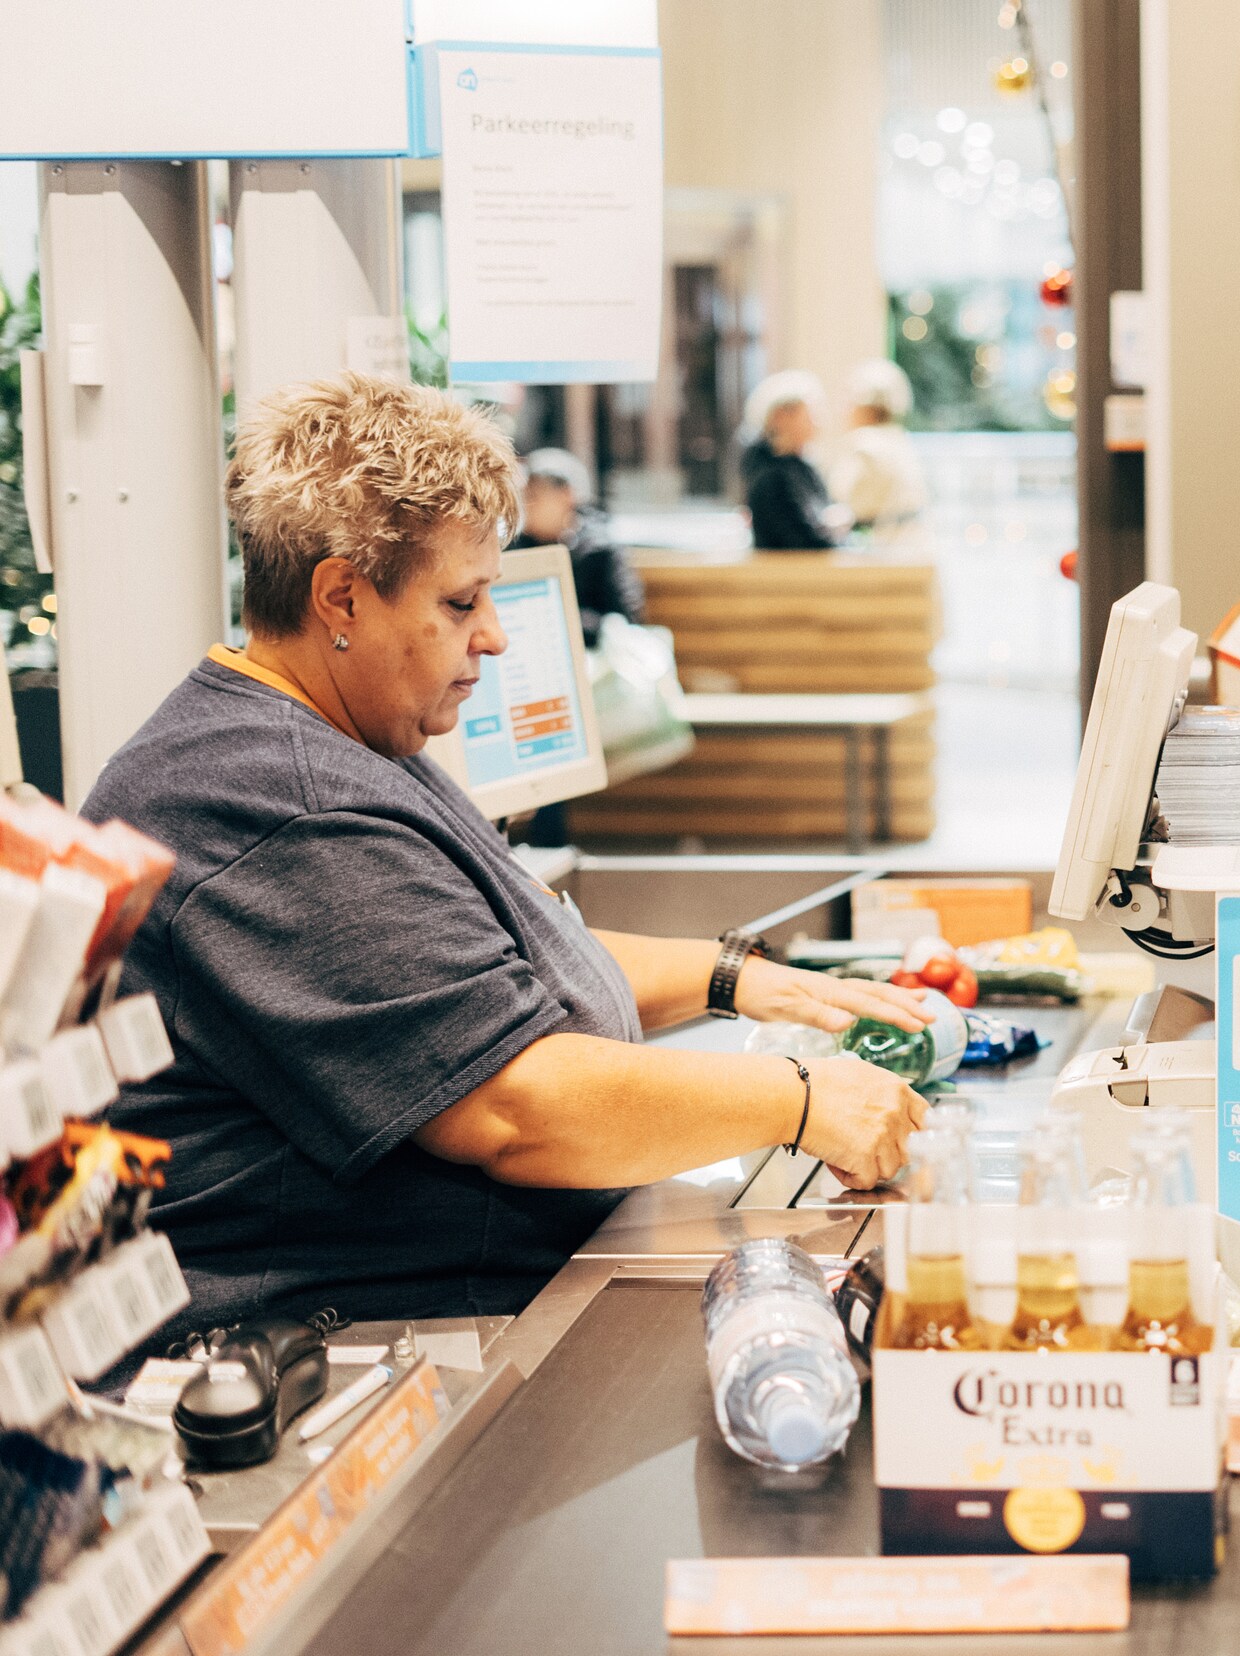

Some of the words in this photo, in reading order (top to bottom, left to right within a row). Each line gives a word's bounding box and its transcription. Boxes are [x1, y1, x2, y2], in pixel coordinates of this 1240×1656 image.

[471, 113, 634, 141] Parkeerregeling
[953, 1368, 1127, 1420] Corona
[1003, 1415, 1093, 1445] Extra
